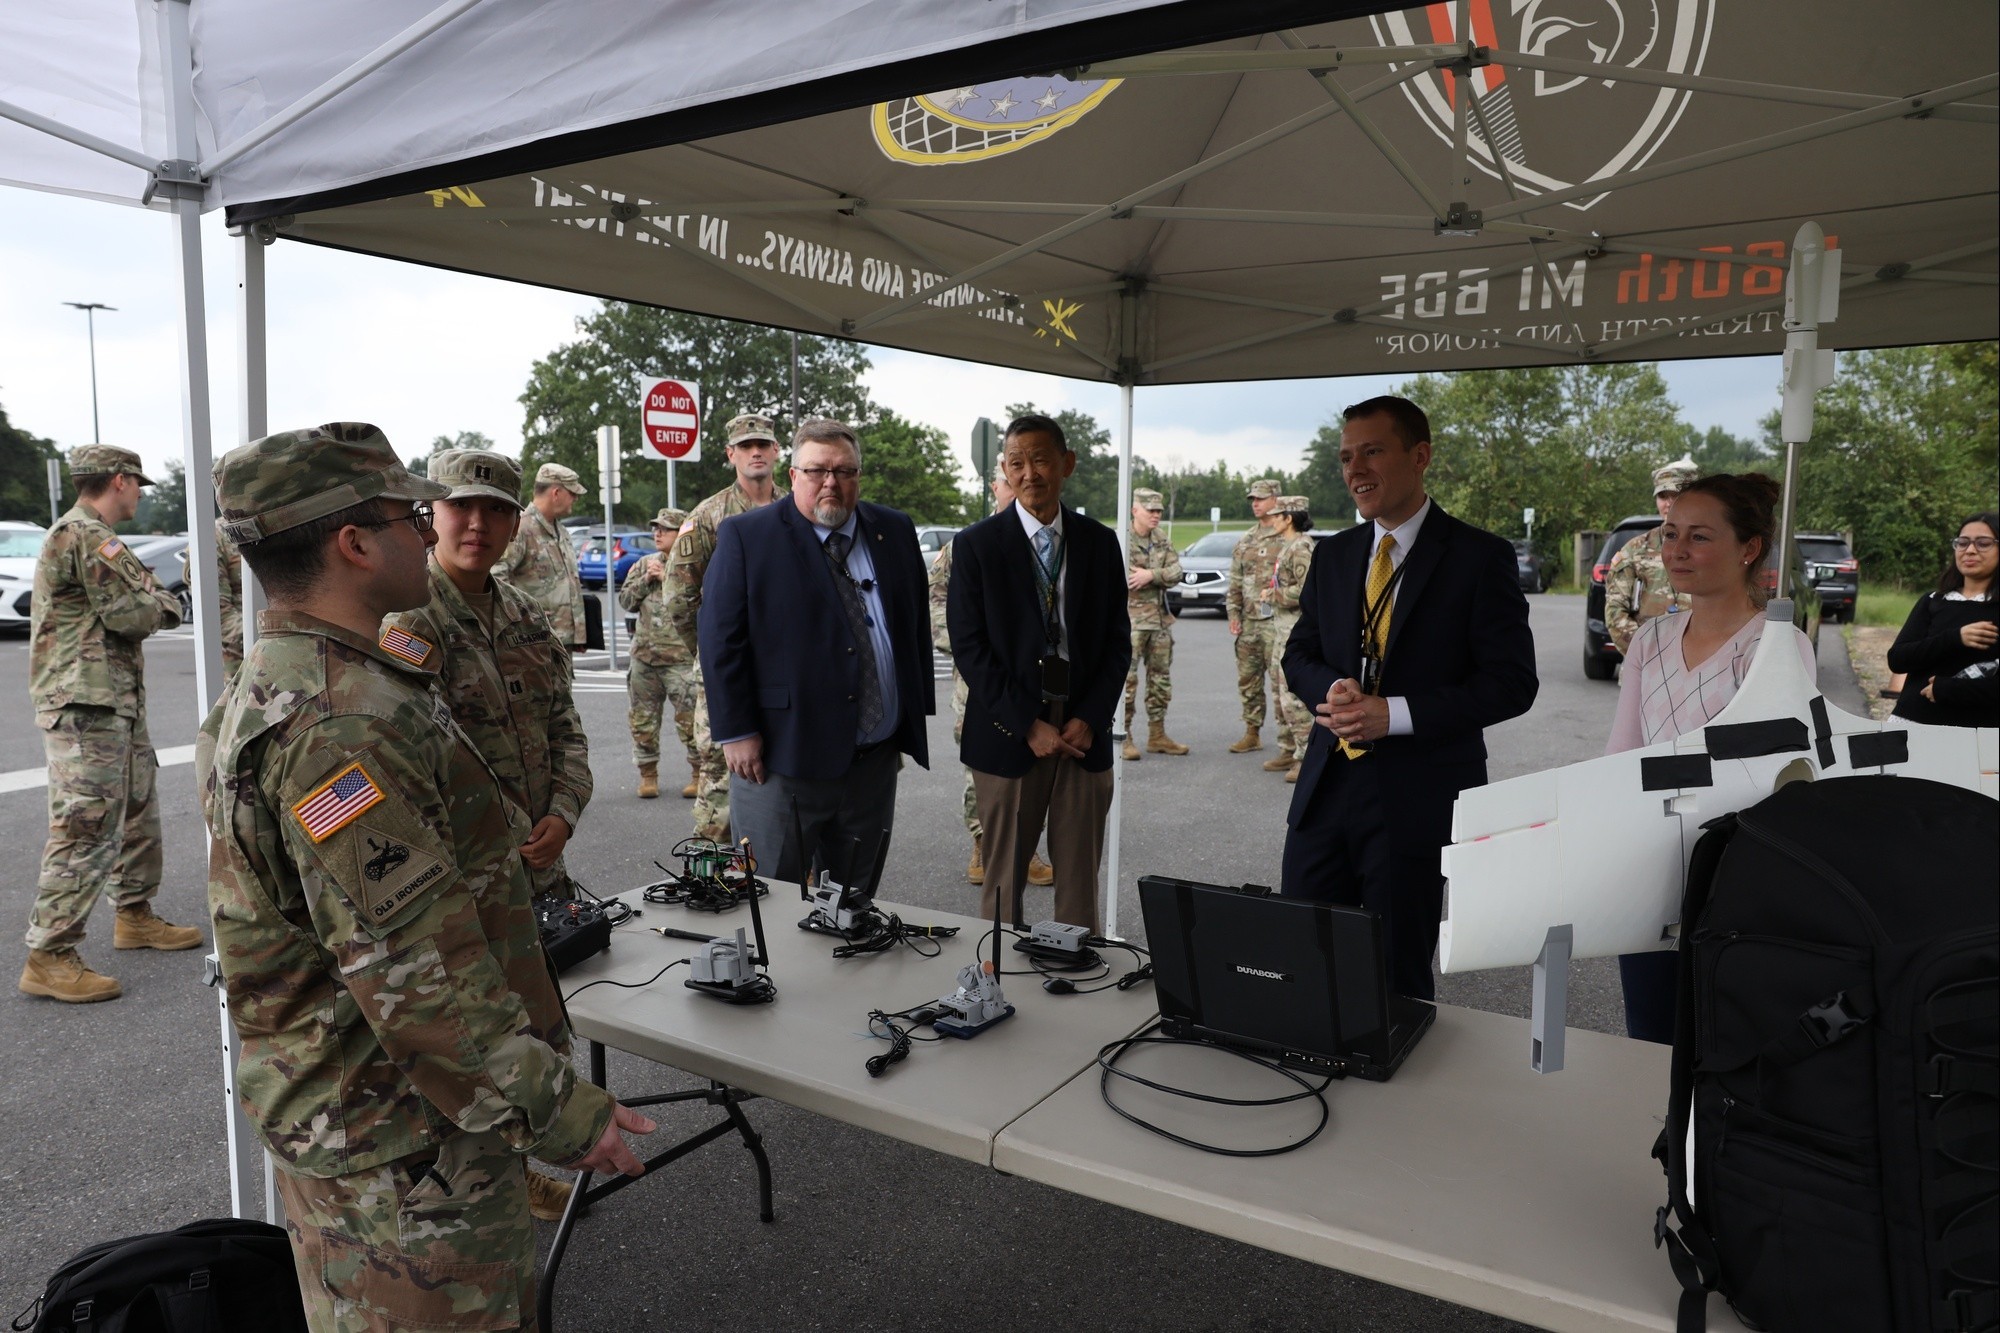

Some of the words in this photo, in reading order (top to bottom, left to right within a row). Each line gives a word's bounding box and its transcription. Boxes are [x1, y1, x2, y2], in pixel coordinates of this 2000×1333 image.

[651, 394, 666, 408] DO
[671, 396, 691, 411] NOT
[656, 429, 688, 444] ENTER
[374, 899, 395, 917] OLD
[395, 863, 443, 901] IRONSIDES
[1236, 965, 1287, 981] DURABOOK
